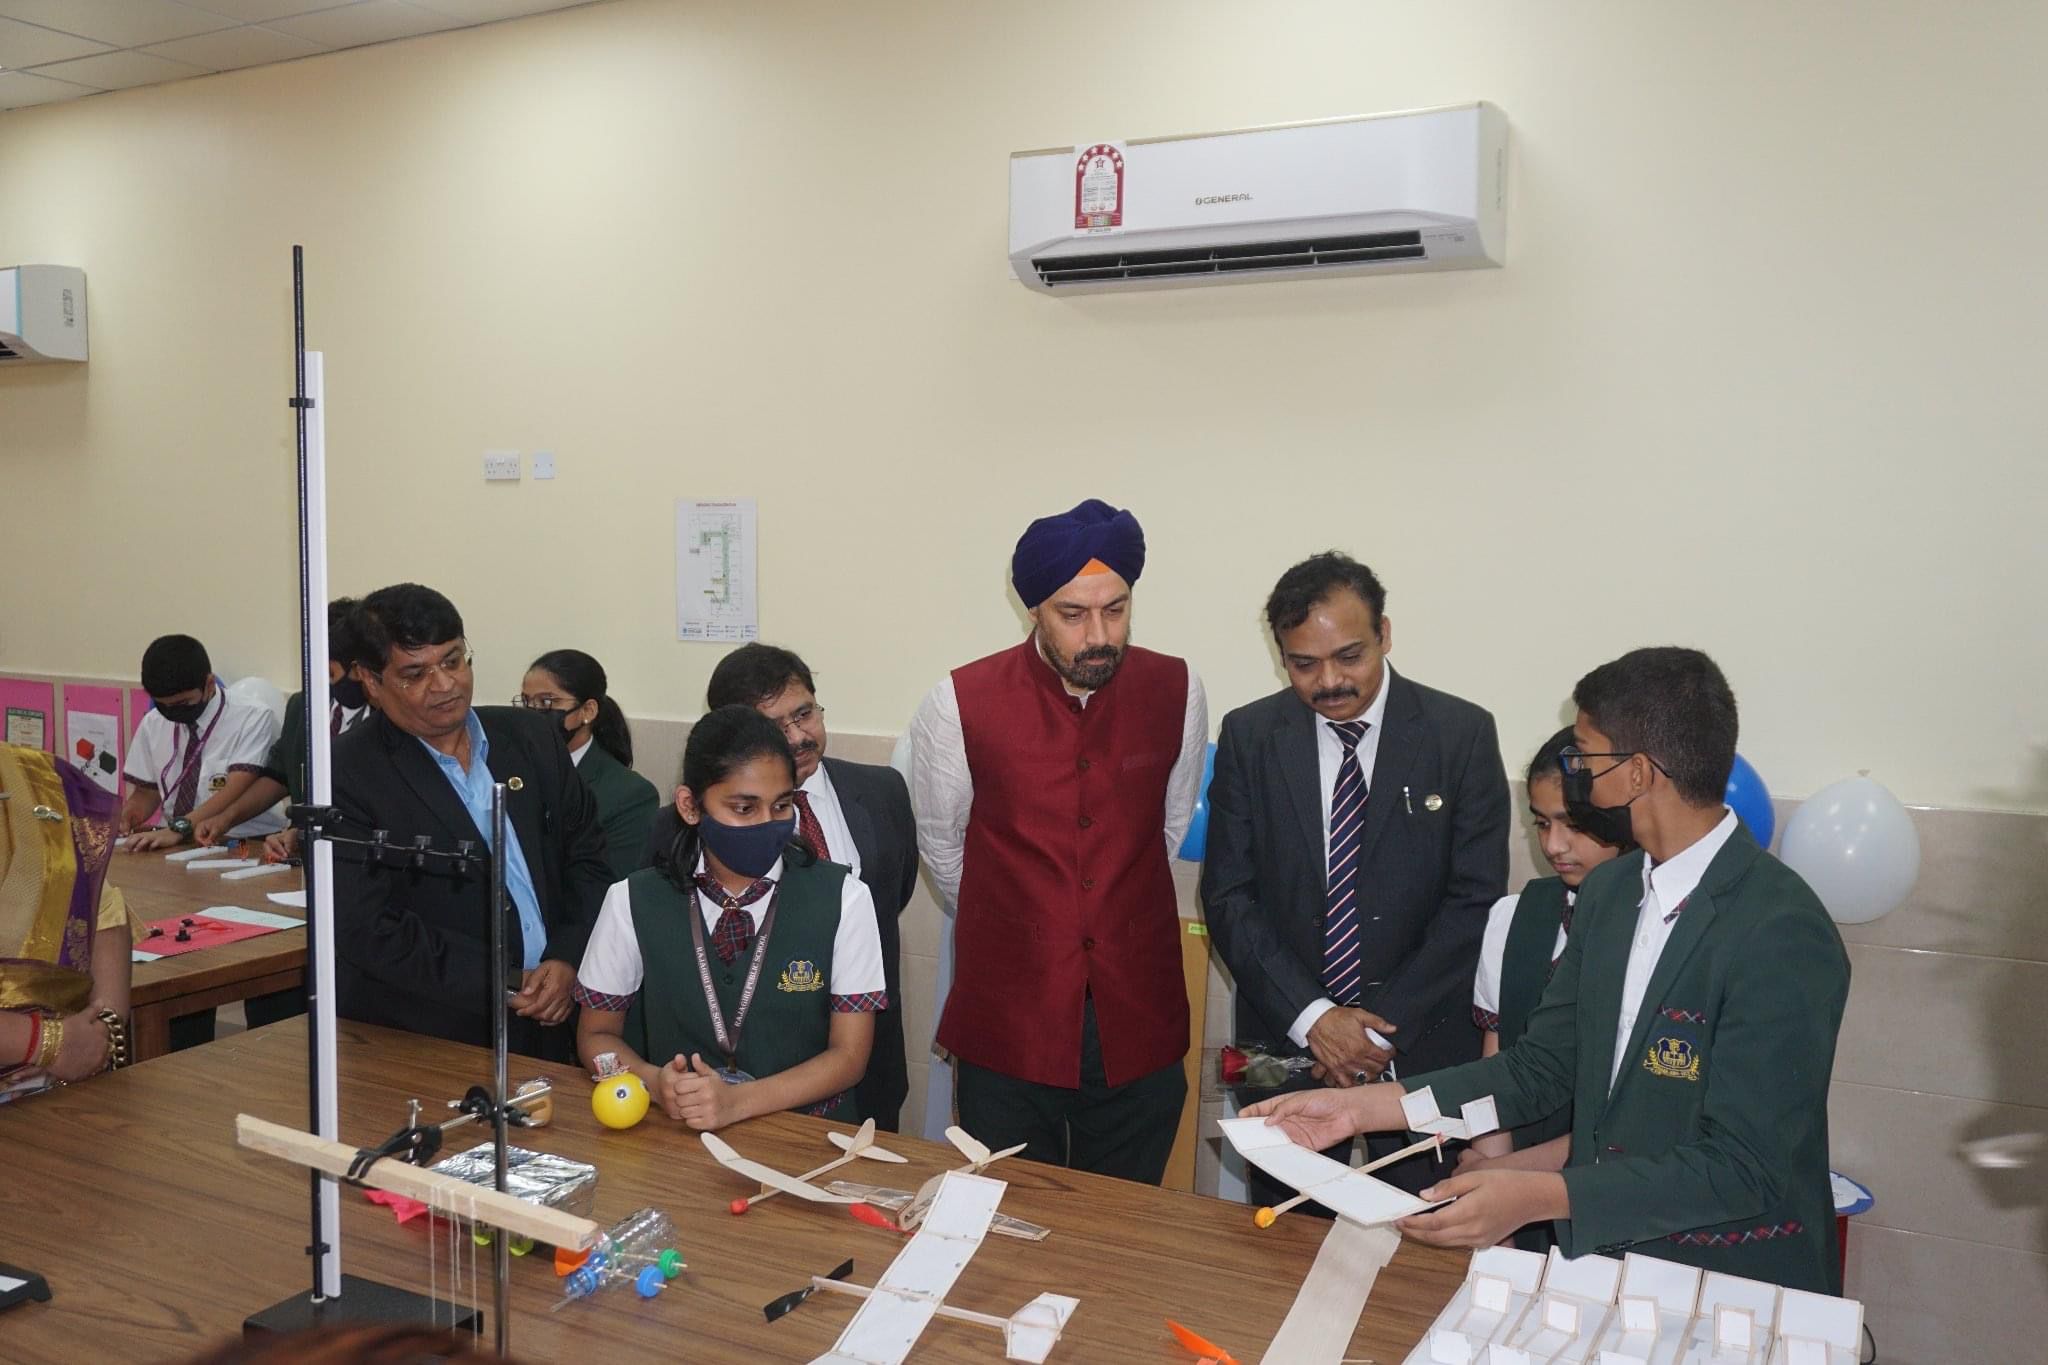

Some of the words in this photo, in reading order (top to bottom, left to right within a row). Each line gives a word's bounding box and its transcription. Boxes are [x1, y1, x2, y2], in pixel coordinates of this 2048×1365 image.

[745, 962, 759, 990] PUBLIC
[754, 934, 768, 962] SCHOOL
[704, 982, 719, 1011] PUBLIC
[711, 1010, 726, 1042] SCHOOL
